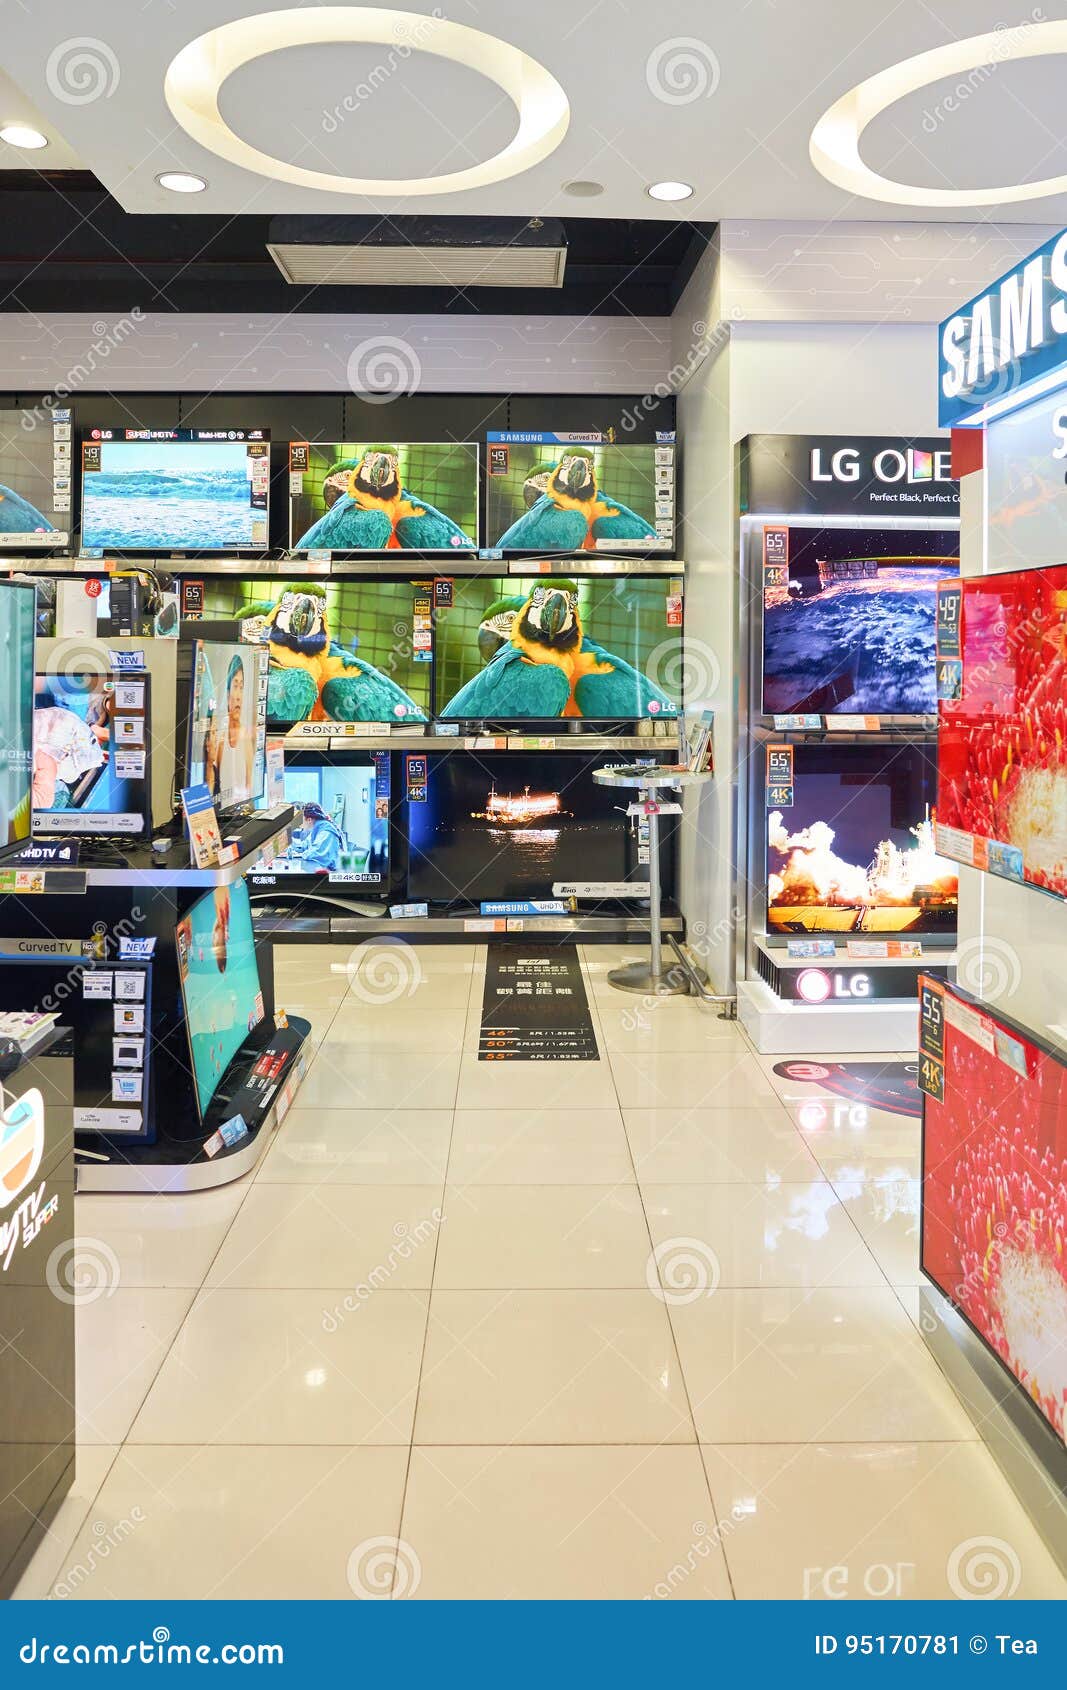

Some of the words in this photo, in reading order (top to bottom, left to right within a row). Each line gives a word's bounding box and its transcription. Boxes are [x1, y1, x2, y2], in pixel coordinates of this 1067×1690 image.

[500, 433, 543, 441] SAMSUNG
[568, 433, 590, 441] Curved
[591, 433, 600, 441] TV
[810, 448, 861, 482] LG
[872, 448, 952, 484] OLE
[869, 493, 898, 502] Perfect
[899, 493, 922, 503] Black,
[923, 494, 951, 503] Perfect
[767, 568, 785, 580] 4K
[117, 656, 139, 665] NEW
[938, 664, 958, 685] 4K
[408, 706, 422, 715] LG
[661, 702, 676, 712] LG
[302, 726, 342, 734] SONY
[409, 787, 424, 797] 4K
[770, 787, 789, 800] 4K
[485, 904, 529, 913] SAMSUNG
[18, 941, 56, 952] Curved
[60, 943, 73, 953] TV
[126, 943, 149, 952] NEW
[834, 974, 870, 997] LG
[921, 1060, 940, 1087] 4K
[23, 1194, 58, 1249] SUPER
